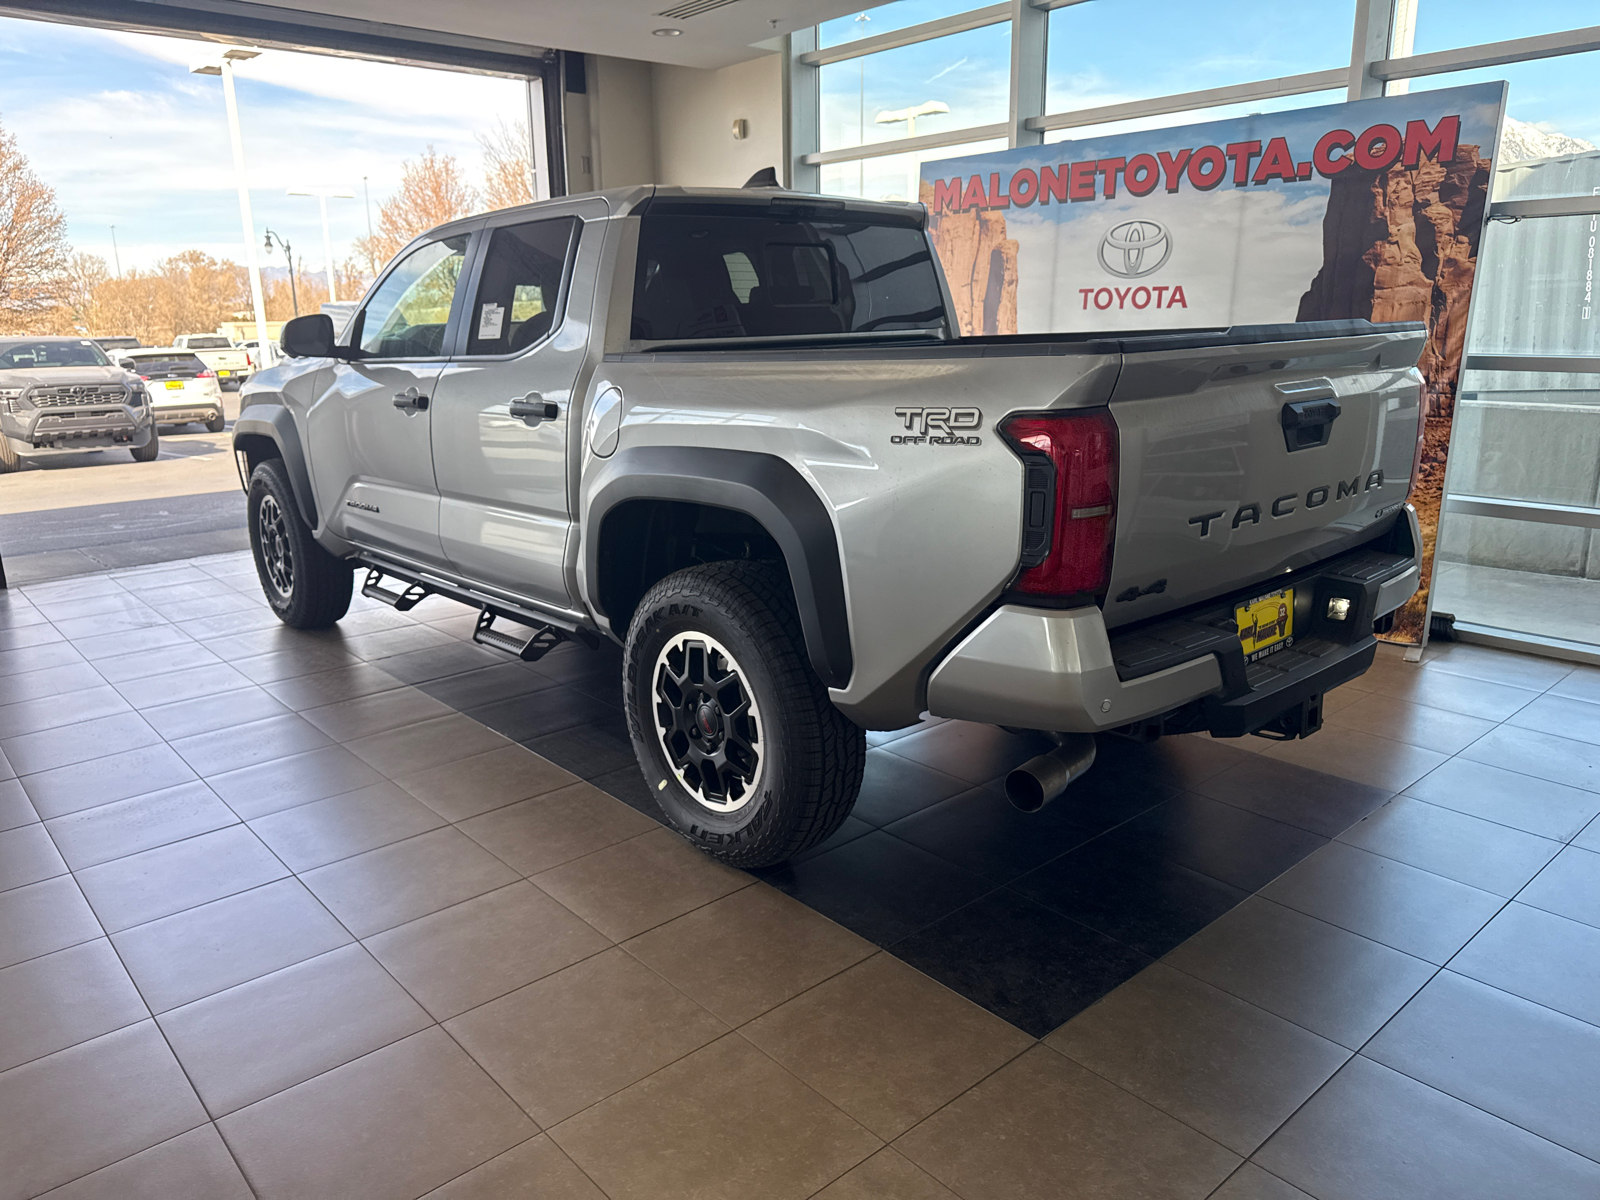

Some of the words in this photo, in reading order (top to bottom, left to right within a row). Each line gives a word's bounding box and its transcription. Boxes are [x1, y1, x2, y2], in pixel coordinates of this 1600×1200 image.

[933, 115, 1461, 214] MALONETOYOTA.COM
[1584, 236, 1595, 303] 081884
[1078, 285, 1188, 311] TOYOTA
[890, 435, 926, 445] OFF
[929, 436, 982, 446] ROAD
[894, 406, 983, 436] TRD
[1188, 469, 1384, 537] TACOMA
[1280, 607, 1286, 616] 32
[626, 606, 667, 744] WILDPEAK
